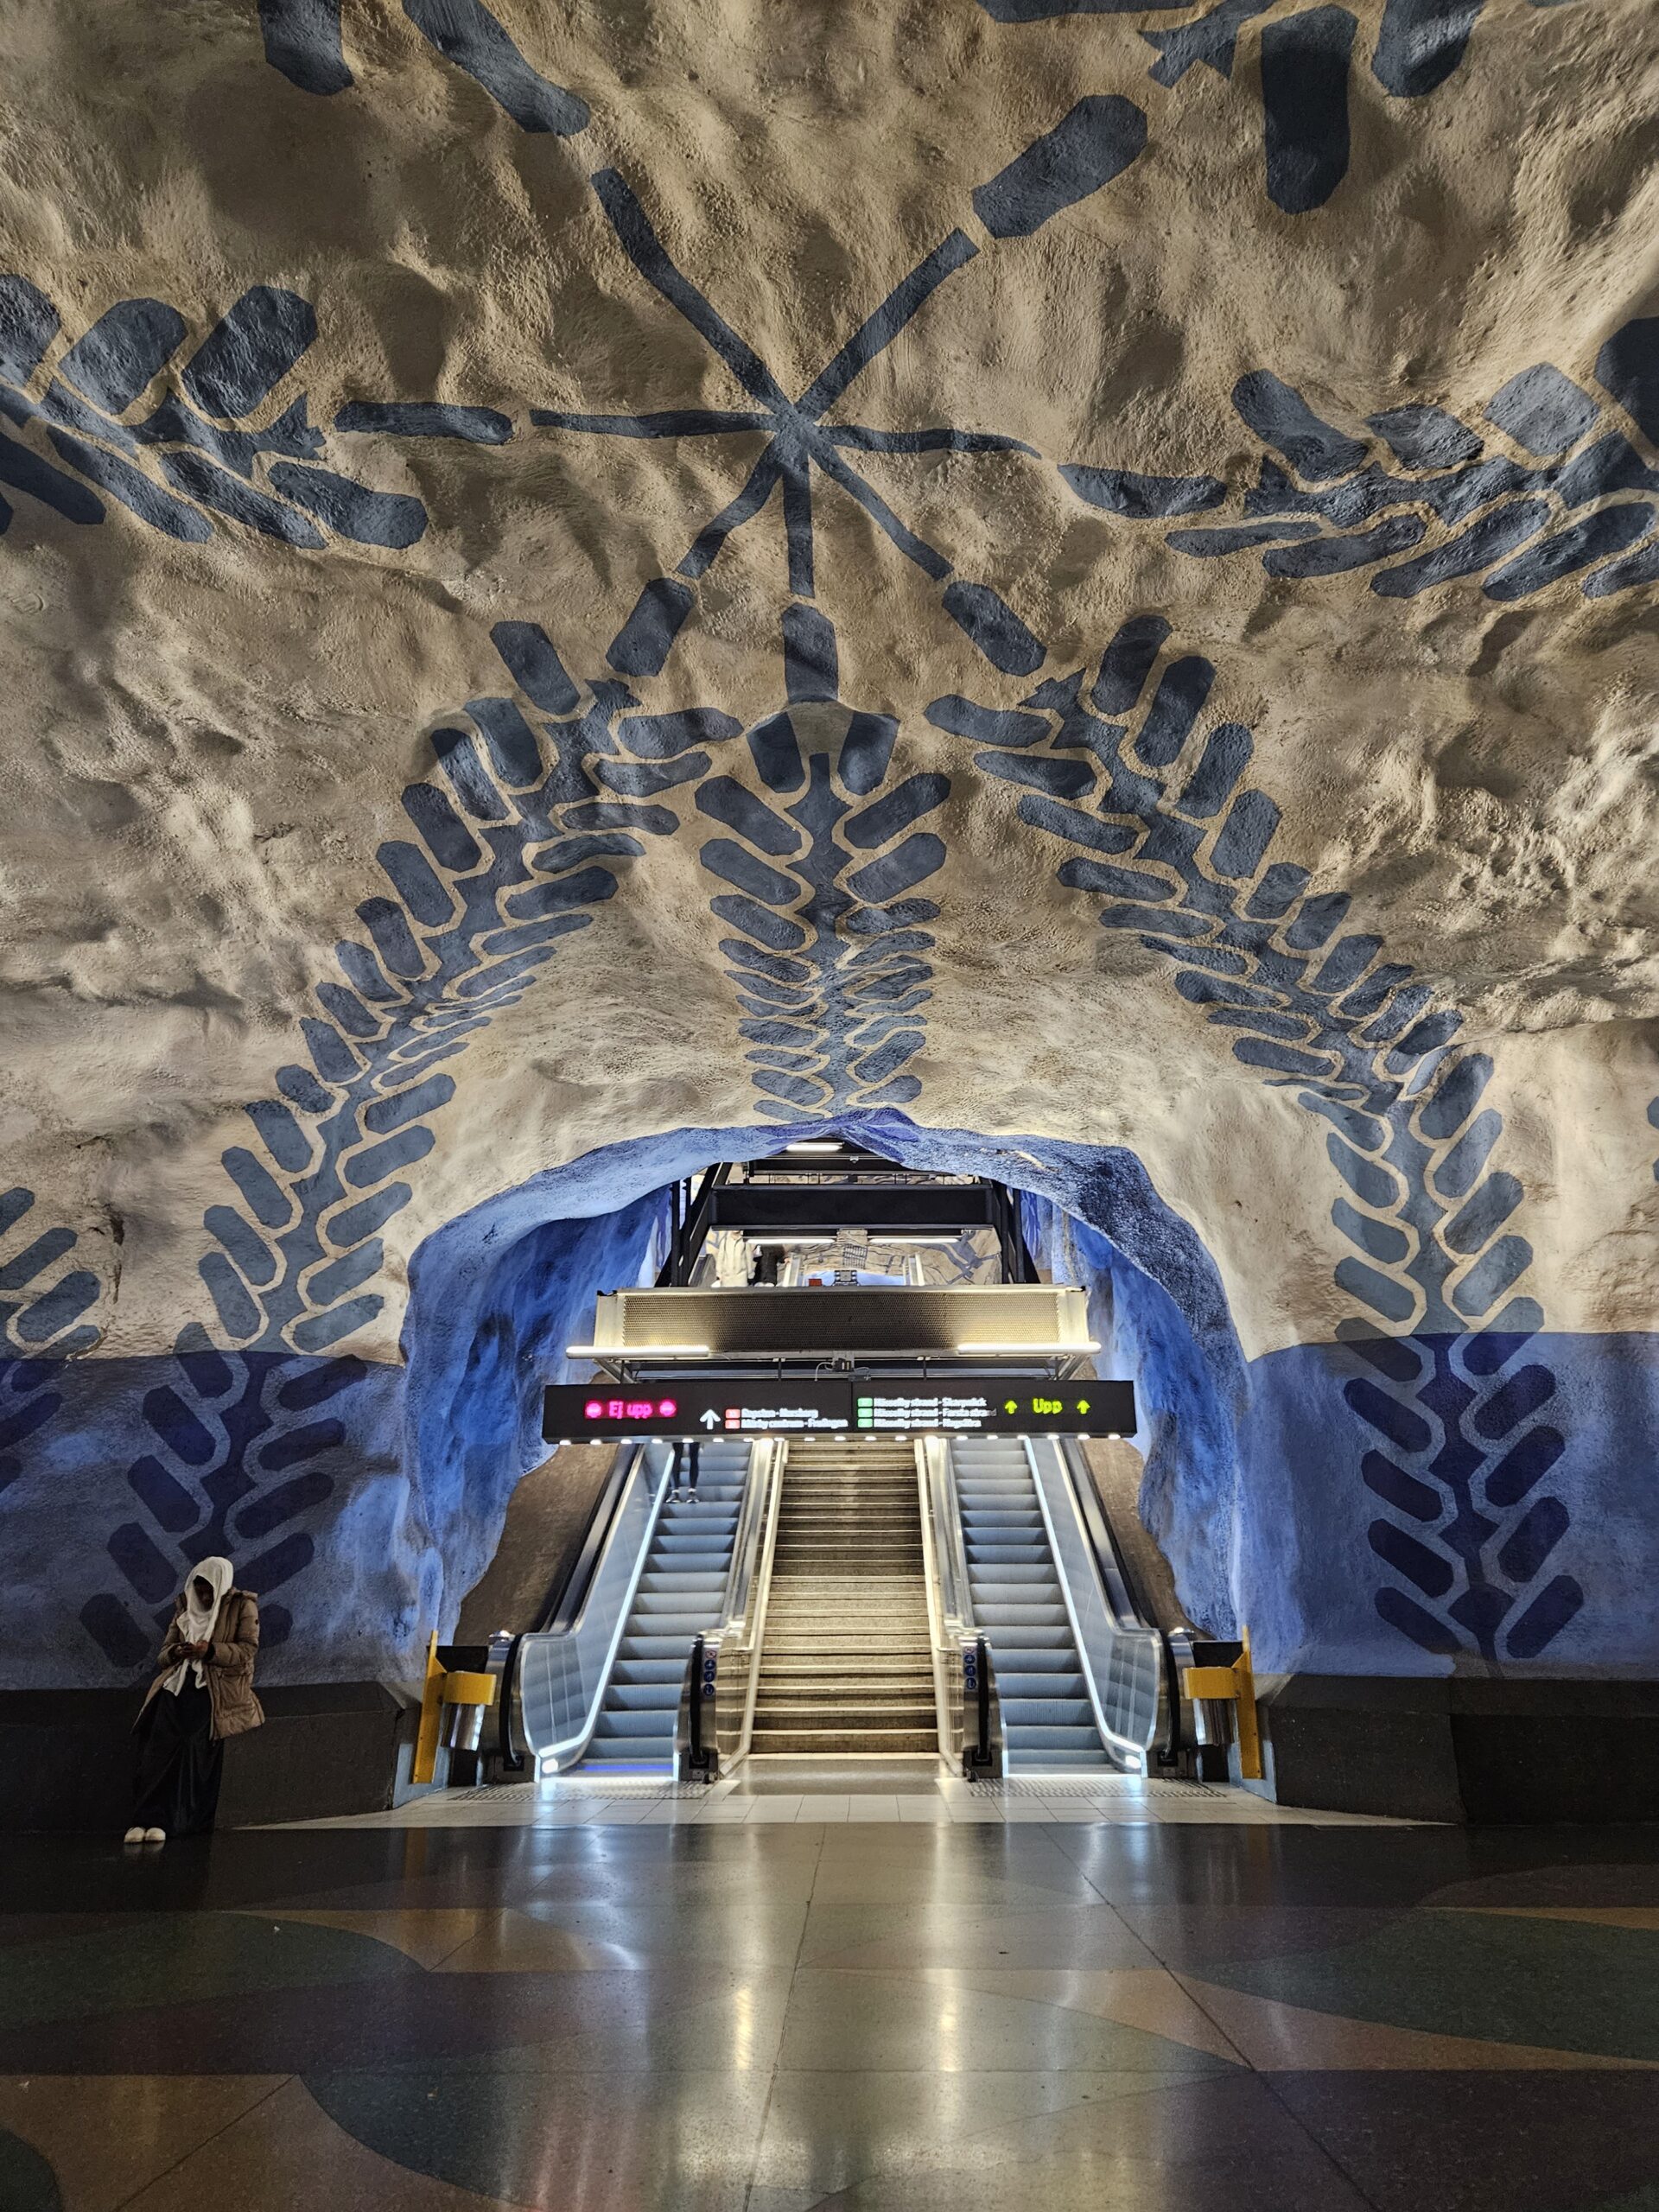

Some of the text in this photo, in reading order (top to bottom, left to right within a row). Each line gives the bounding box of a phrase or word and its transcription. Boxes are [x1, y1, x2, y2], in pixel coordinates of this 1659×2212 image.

[608, 1400, 653, 1420] Ej upp
[1033, 1397, 1063, 1414] Upp
